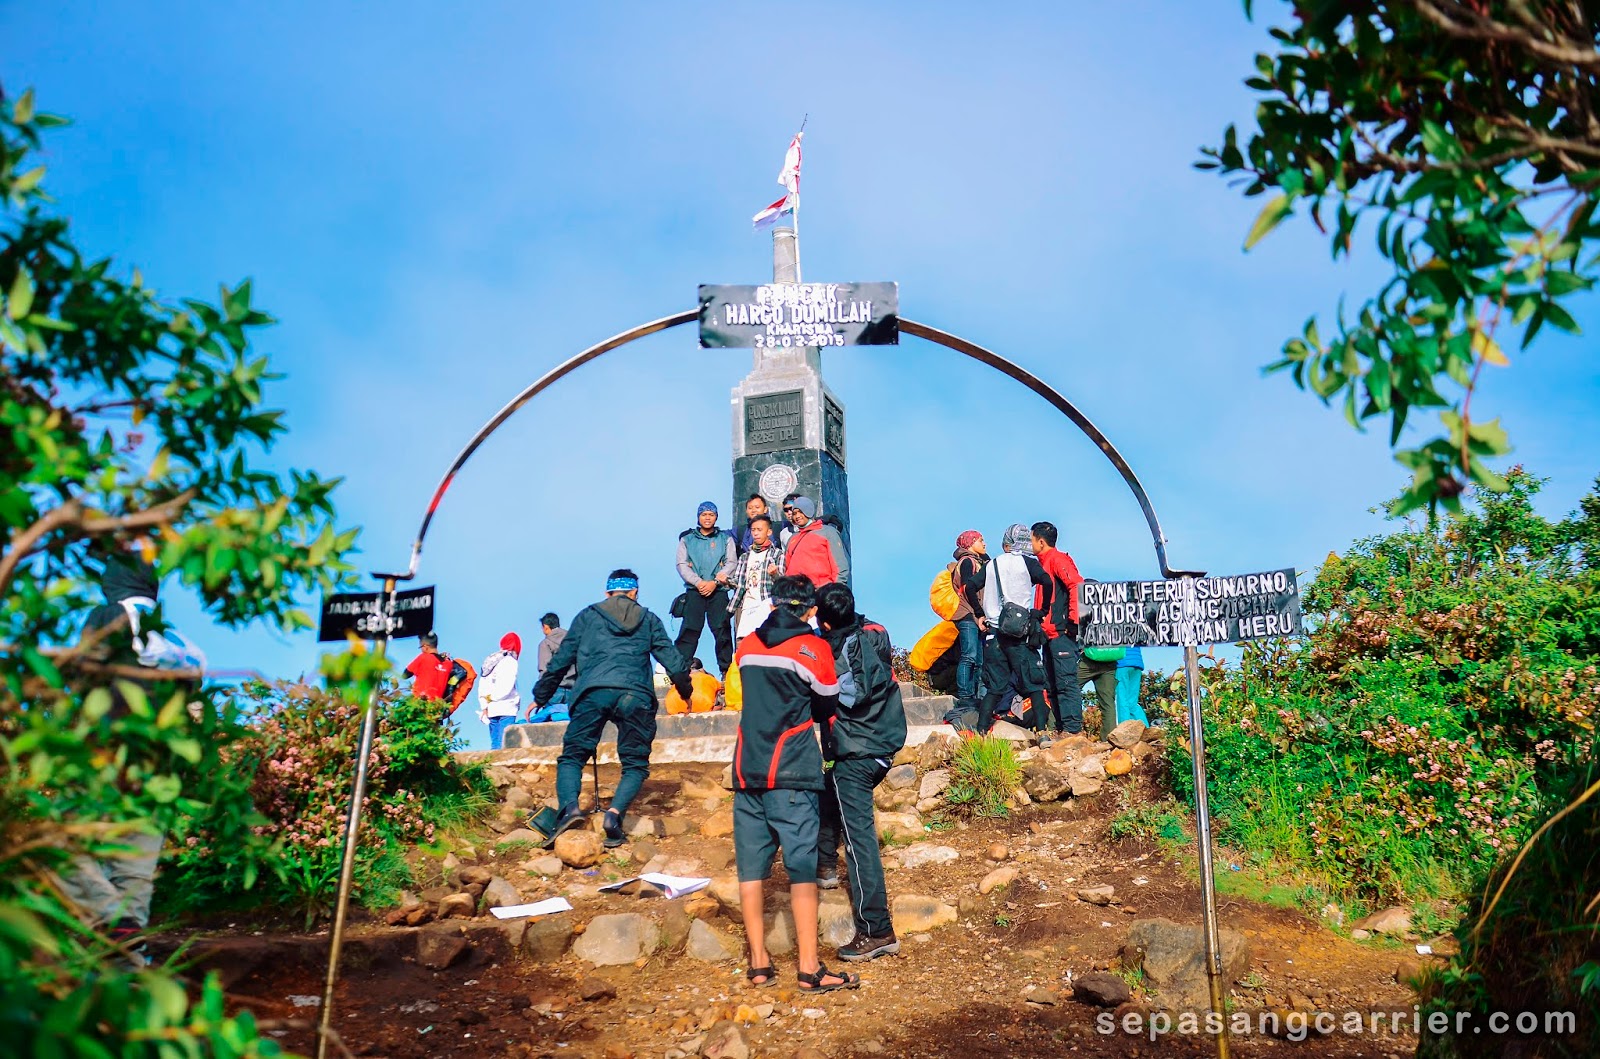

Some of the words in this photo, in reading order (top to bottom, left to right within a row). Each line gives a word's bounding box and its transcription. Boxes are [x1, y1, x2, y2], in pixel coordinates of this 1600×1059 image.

[757, 284, 838, 306] PUNCAK
[725, 302, 784, 325] HARGO
[791, 300, 873, 324] DUMILAH
[766, 322, 833, 335] KHARISMA
[779, 428, 798, 442] DPL
[1084, 582, 1128, 605] RYAN
[1092, 602, 1146, 624] INDRI
[1158, 599, 1219, 623] AGUNG
[1239, 612, 1293, 638] HERU
